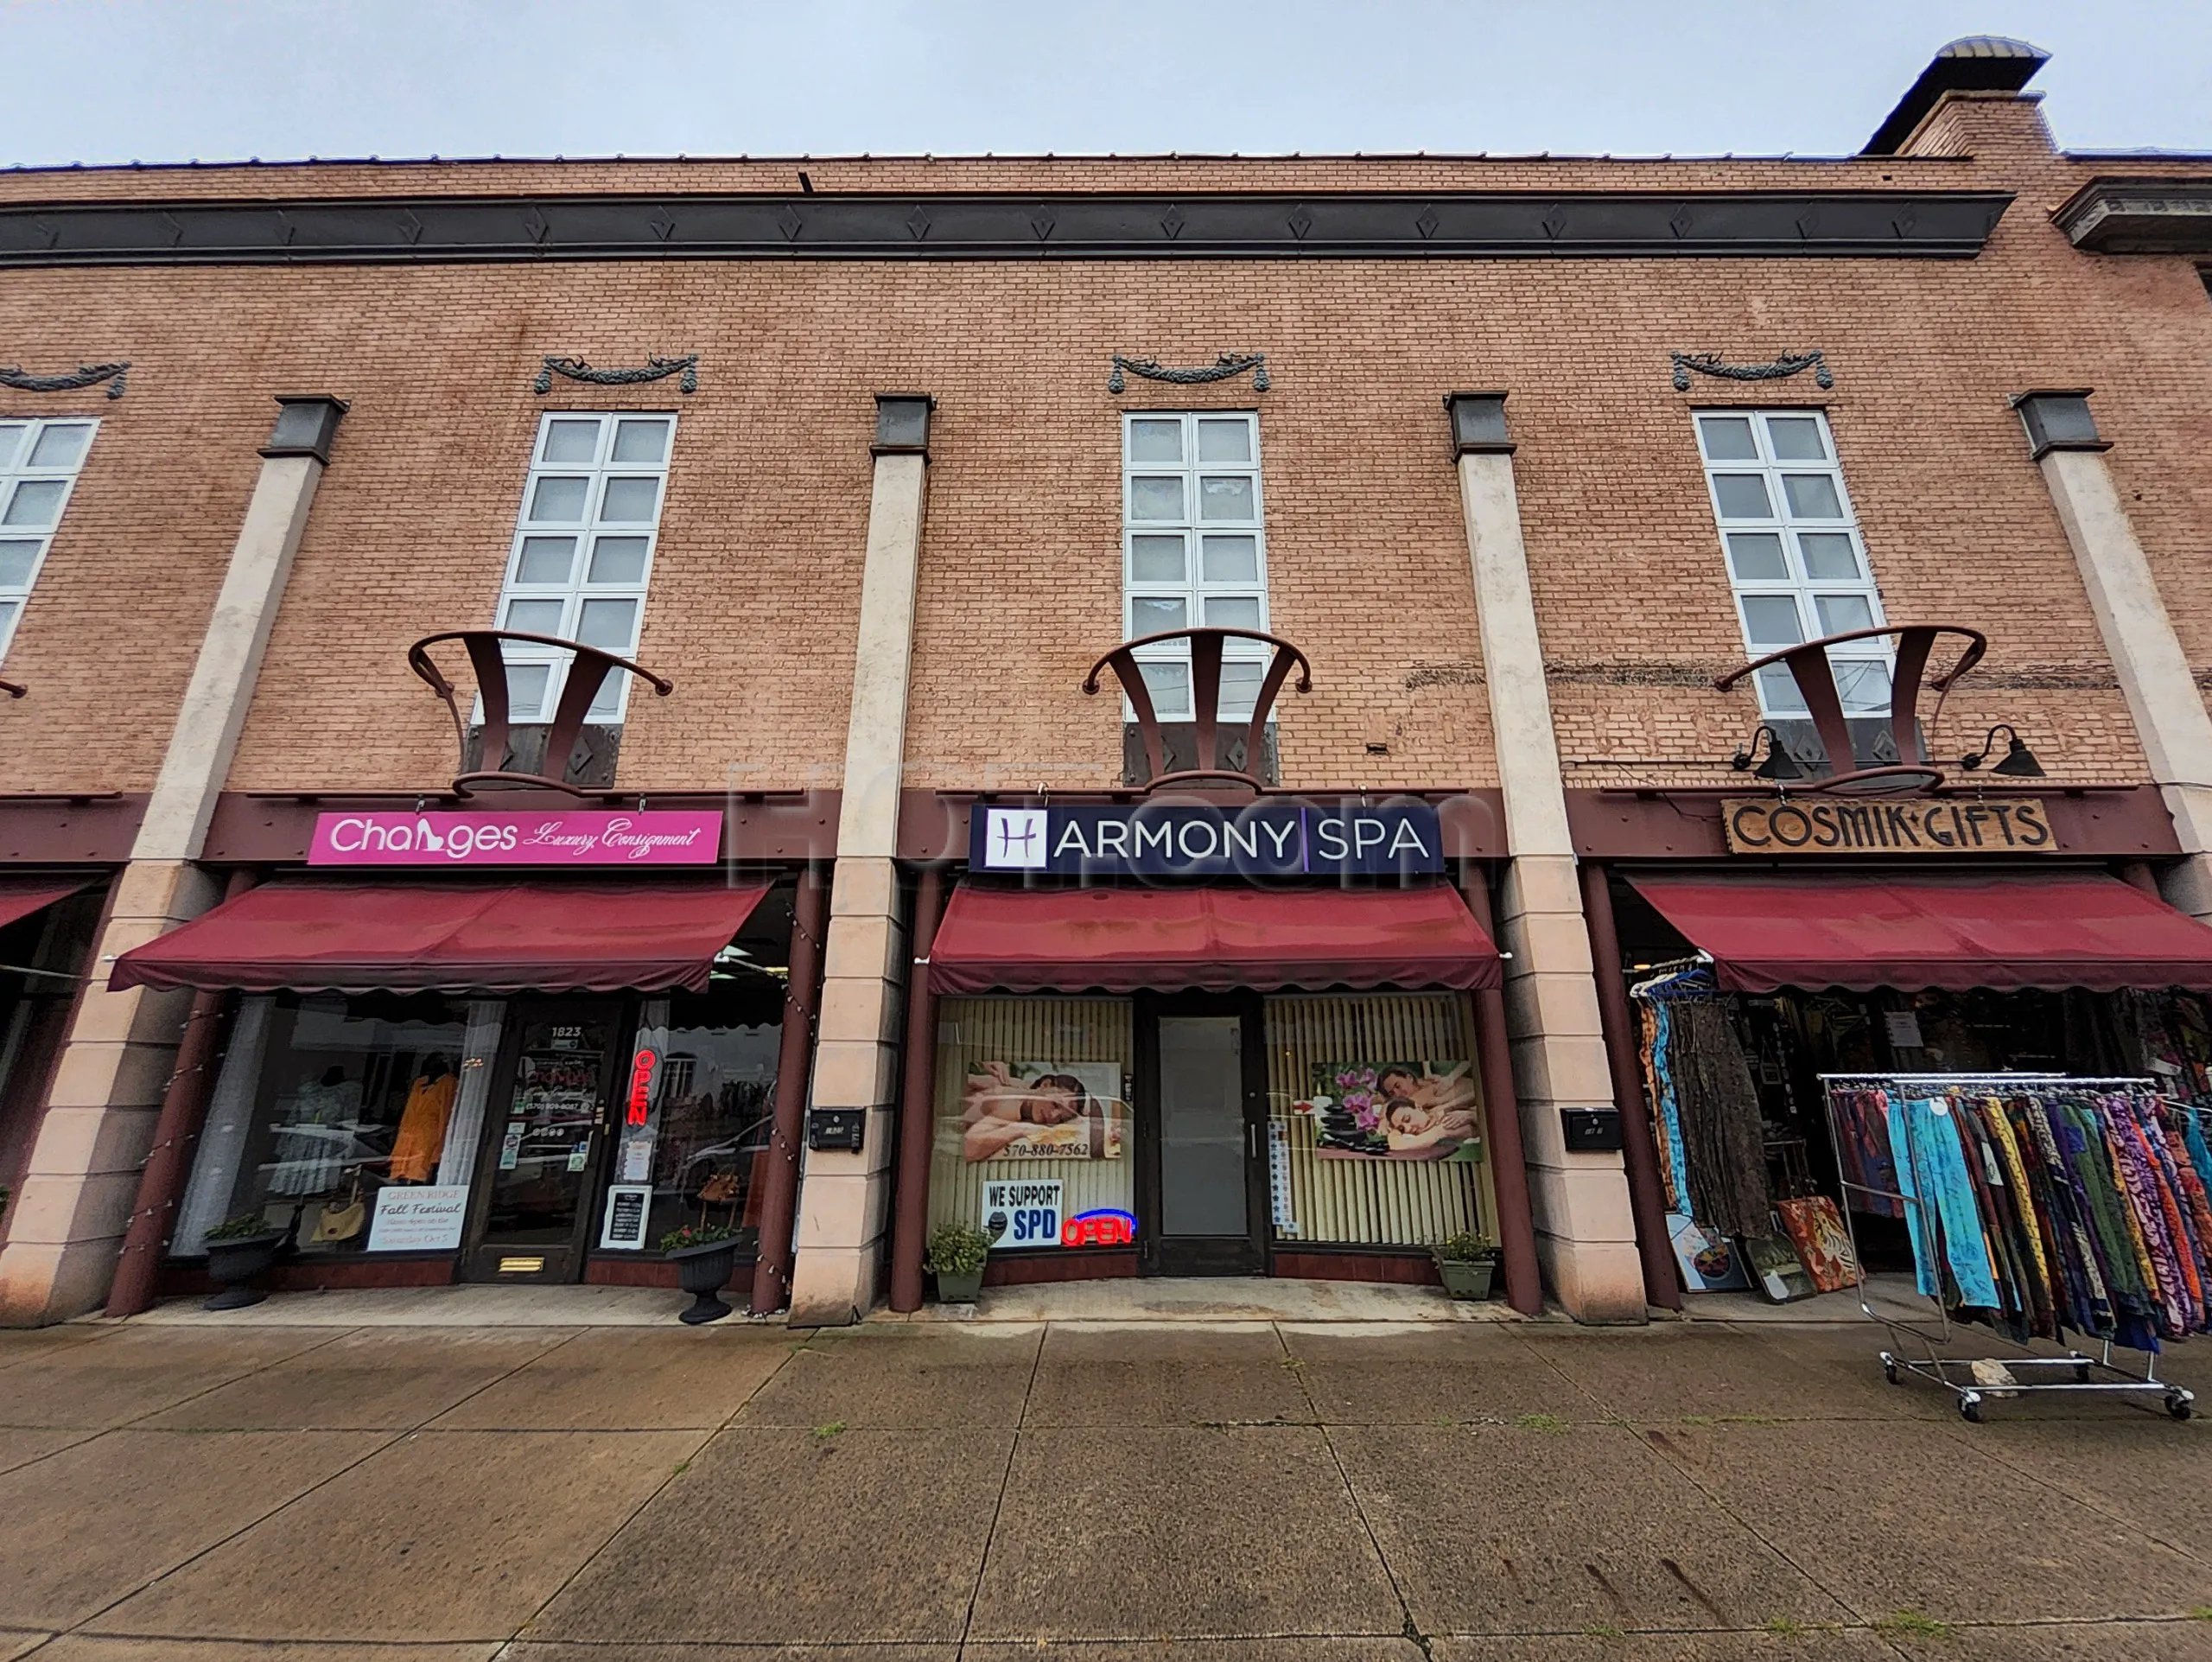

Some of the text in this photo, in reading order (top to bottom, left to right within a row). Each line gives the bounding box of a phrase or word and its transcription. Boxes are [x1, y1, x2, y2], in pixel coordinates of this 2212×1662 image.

[523, 817, 702, 860] Luxury Consignment
[1316, 817, 1430, 861] SPA
[1732, 805, 2050, 846] COSMIK GIFTS
[552, 1027, 582, 1037] 1823
[627, 1049, 656, 1127] OPEN
[1003, 1143, 1089, 1156] 570-880-7562
[380, 1201, 462, 1217] Fall Festival
[988, 1185, 1060, 1207] WE SUPPORT
[1014, 1209, 1056, 1240] SPD
[1062, 1217, 1132, 1246] OPEN
